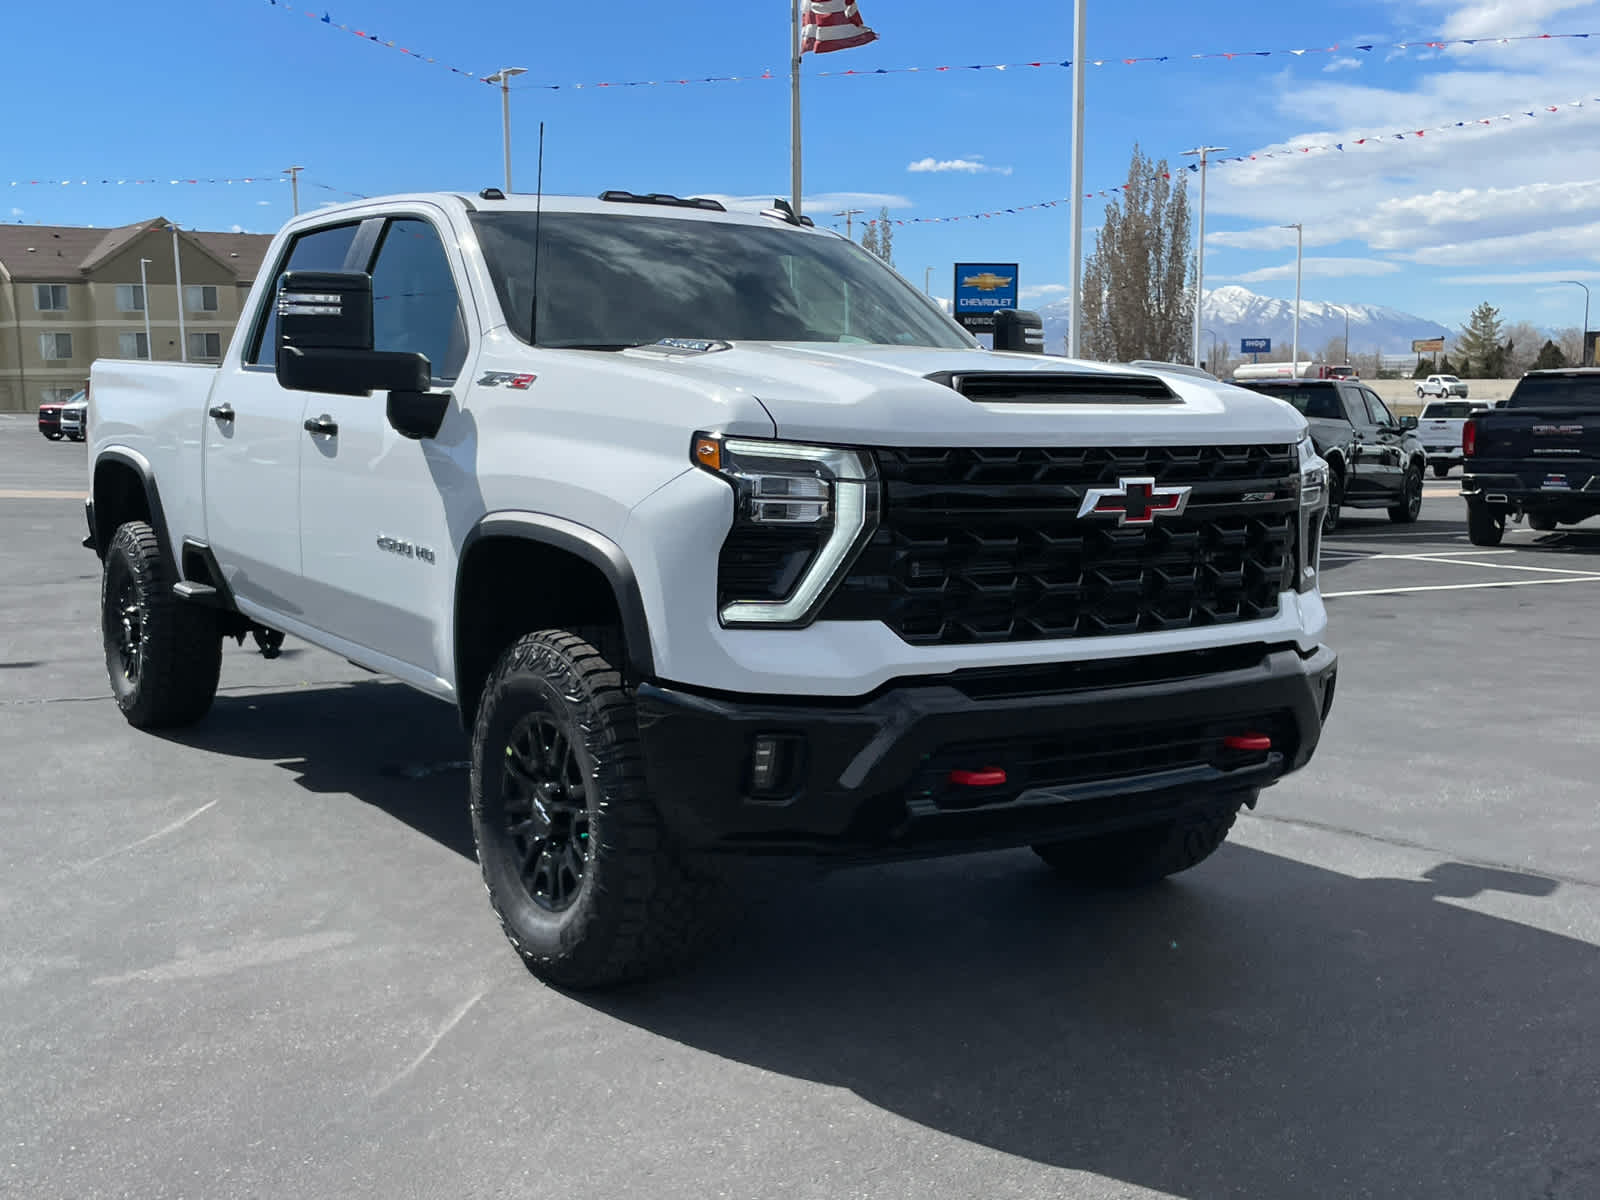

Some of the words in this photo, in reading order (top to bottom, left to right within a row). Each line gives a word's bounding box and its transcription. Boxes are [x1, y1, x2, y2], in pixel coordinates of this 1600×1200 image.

[960, 298, 1012, 306] CHEVROLET
[964, 317, 995, 325] MURDOC
[477, 370, 537, 390] ZR2
[376, 536, 414, 559] 2500
[415, 545, 436, 565] HD
